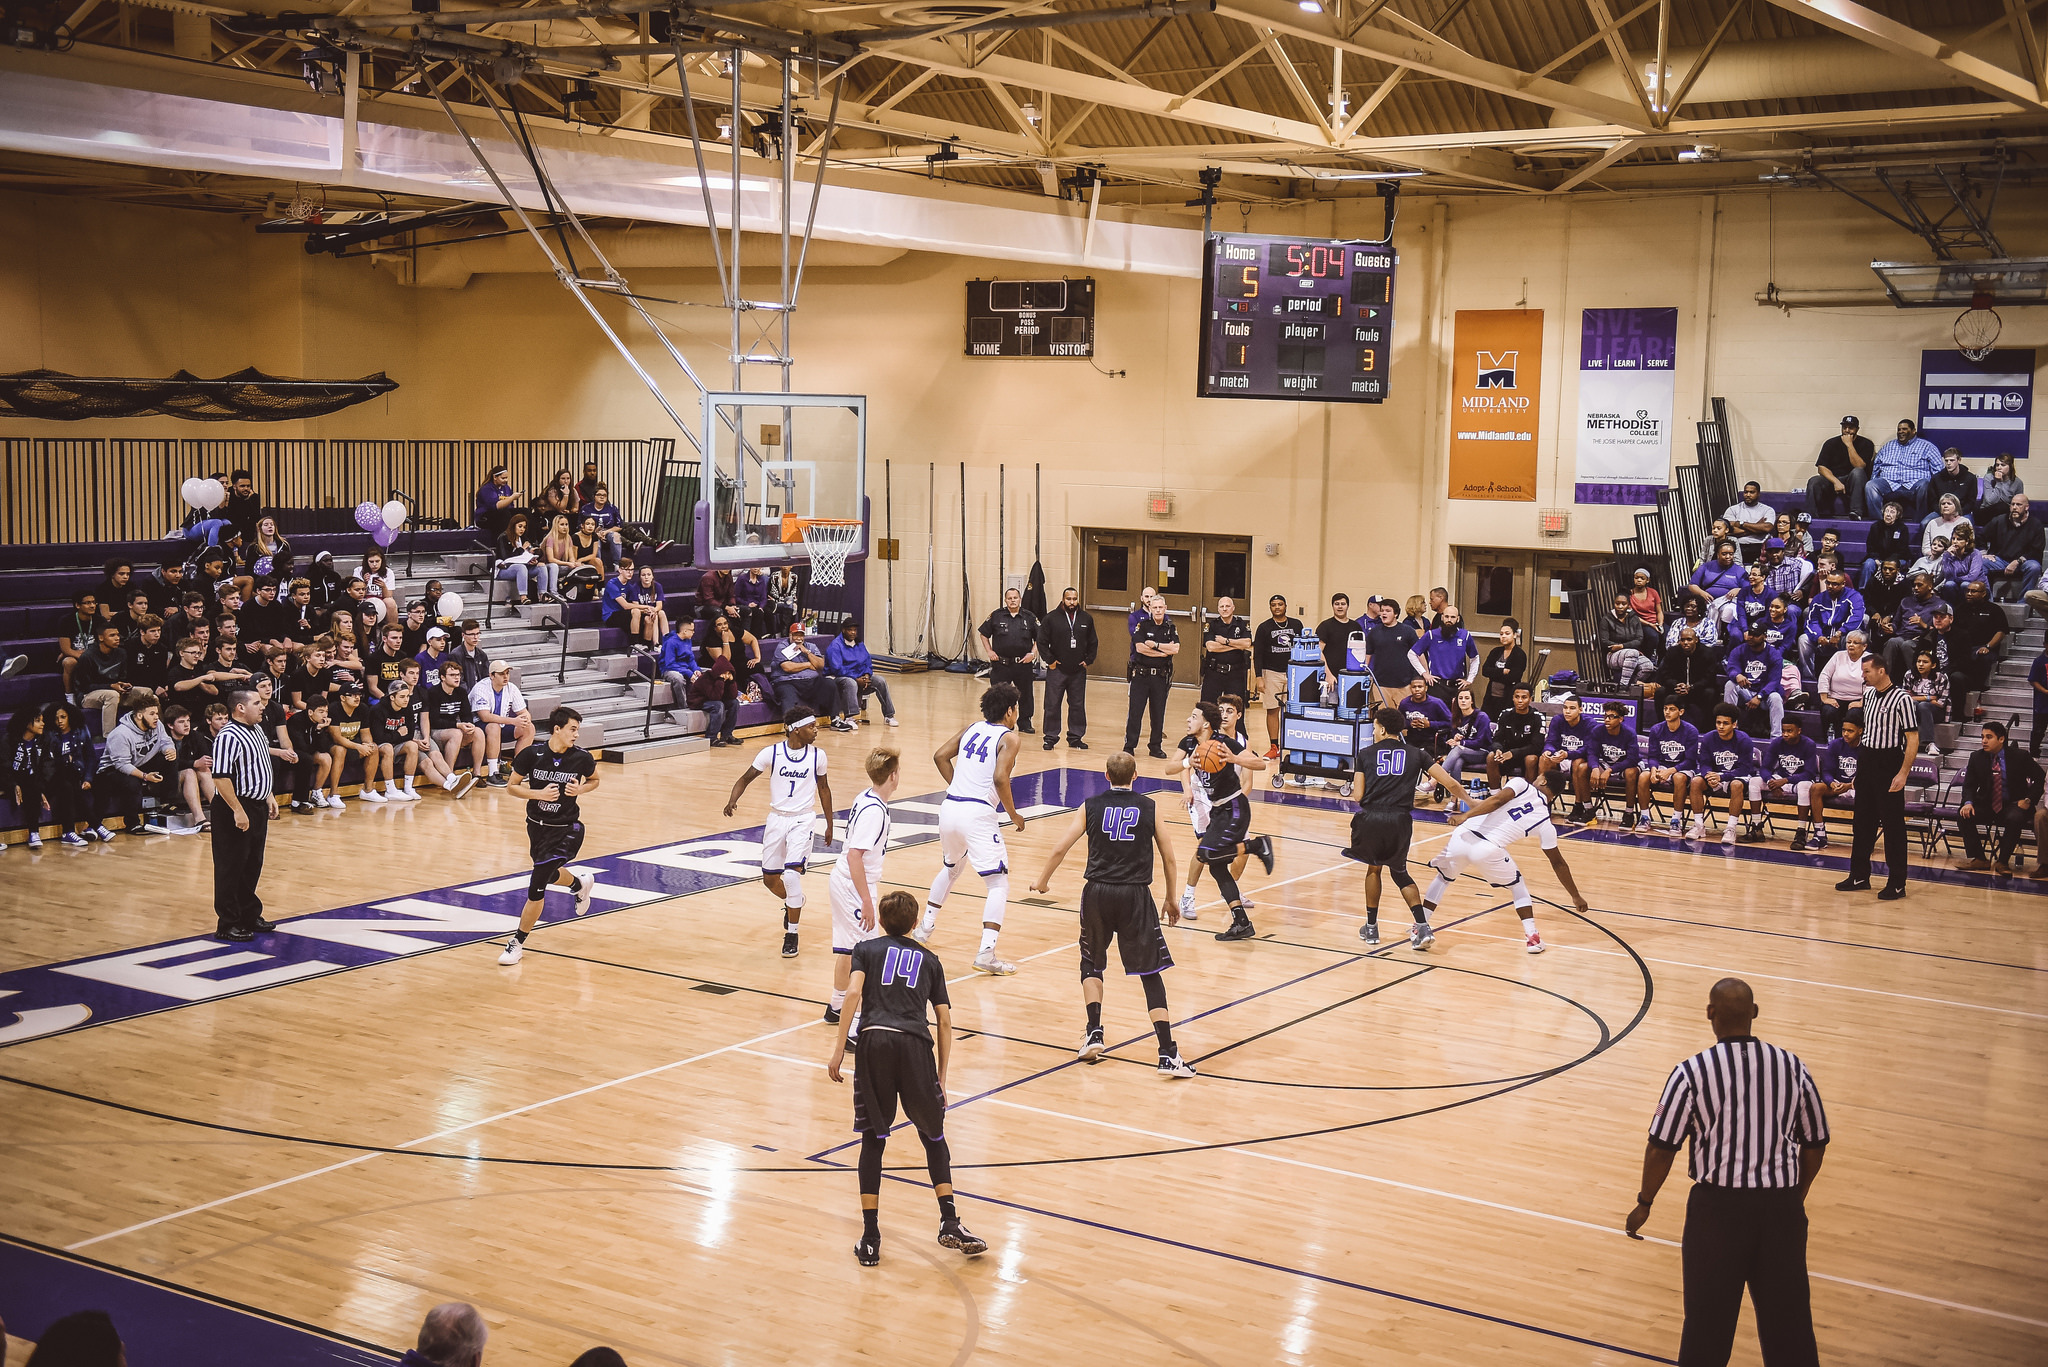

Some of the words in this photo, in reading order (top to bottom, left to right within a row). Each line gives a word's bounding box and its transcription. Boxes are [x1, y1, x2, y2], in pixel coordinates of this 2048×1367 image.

[1226, 245, 1256, 260] Home
[1355, 252, 1391, 268] Guests
[1287, 245, 1345, 277] 5:04
[1242, 266, 1258, 298] 5
[1288, 298, 1322, 313] period
[1014, 326, 1040, 335] PERIOD
[1225, 322, 1250, 336] fouls
[1285, 324, 1319, 340] player
[1355, 328, 1379, 342] fouls
[973, 344, 1000, 355] HOME
[1050, 344, 1087, 356] VISITOR
[1363, 349, 1374, 371] 3
[1220, 375, 1249, 388] match
[1283, 376, 1318, 391] weight
[1352, 379, 1380, 393] match
[1462, 396, 1530, 408] MIDLAND
[1586, 420, 1659, 429] METHODIST
[1457, 430, 1532, 441] www.MidlandU.edu
[1287, 729, 1350, 744] POWERADE
[963, 732, 991, 763] 44
[1376, 749, 1407, 776] 50
[779, 766, 809, 779] Central
[787, 780, 796, 797] 1
[1507, 802, 1534, 821] 2
[1102, 806, 1141, 841] 42
[881, 946, 923, 989] 14
